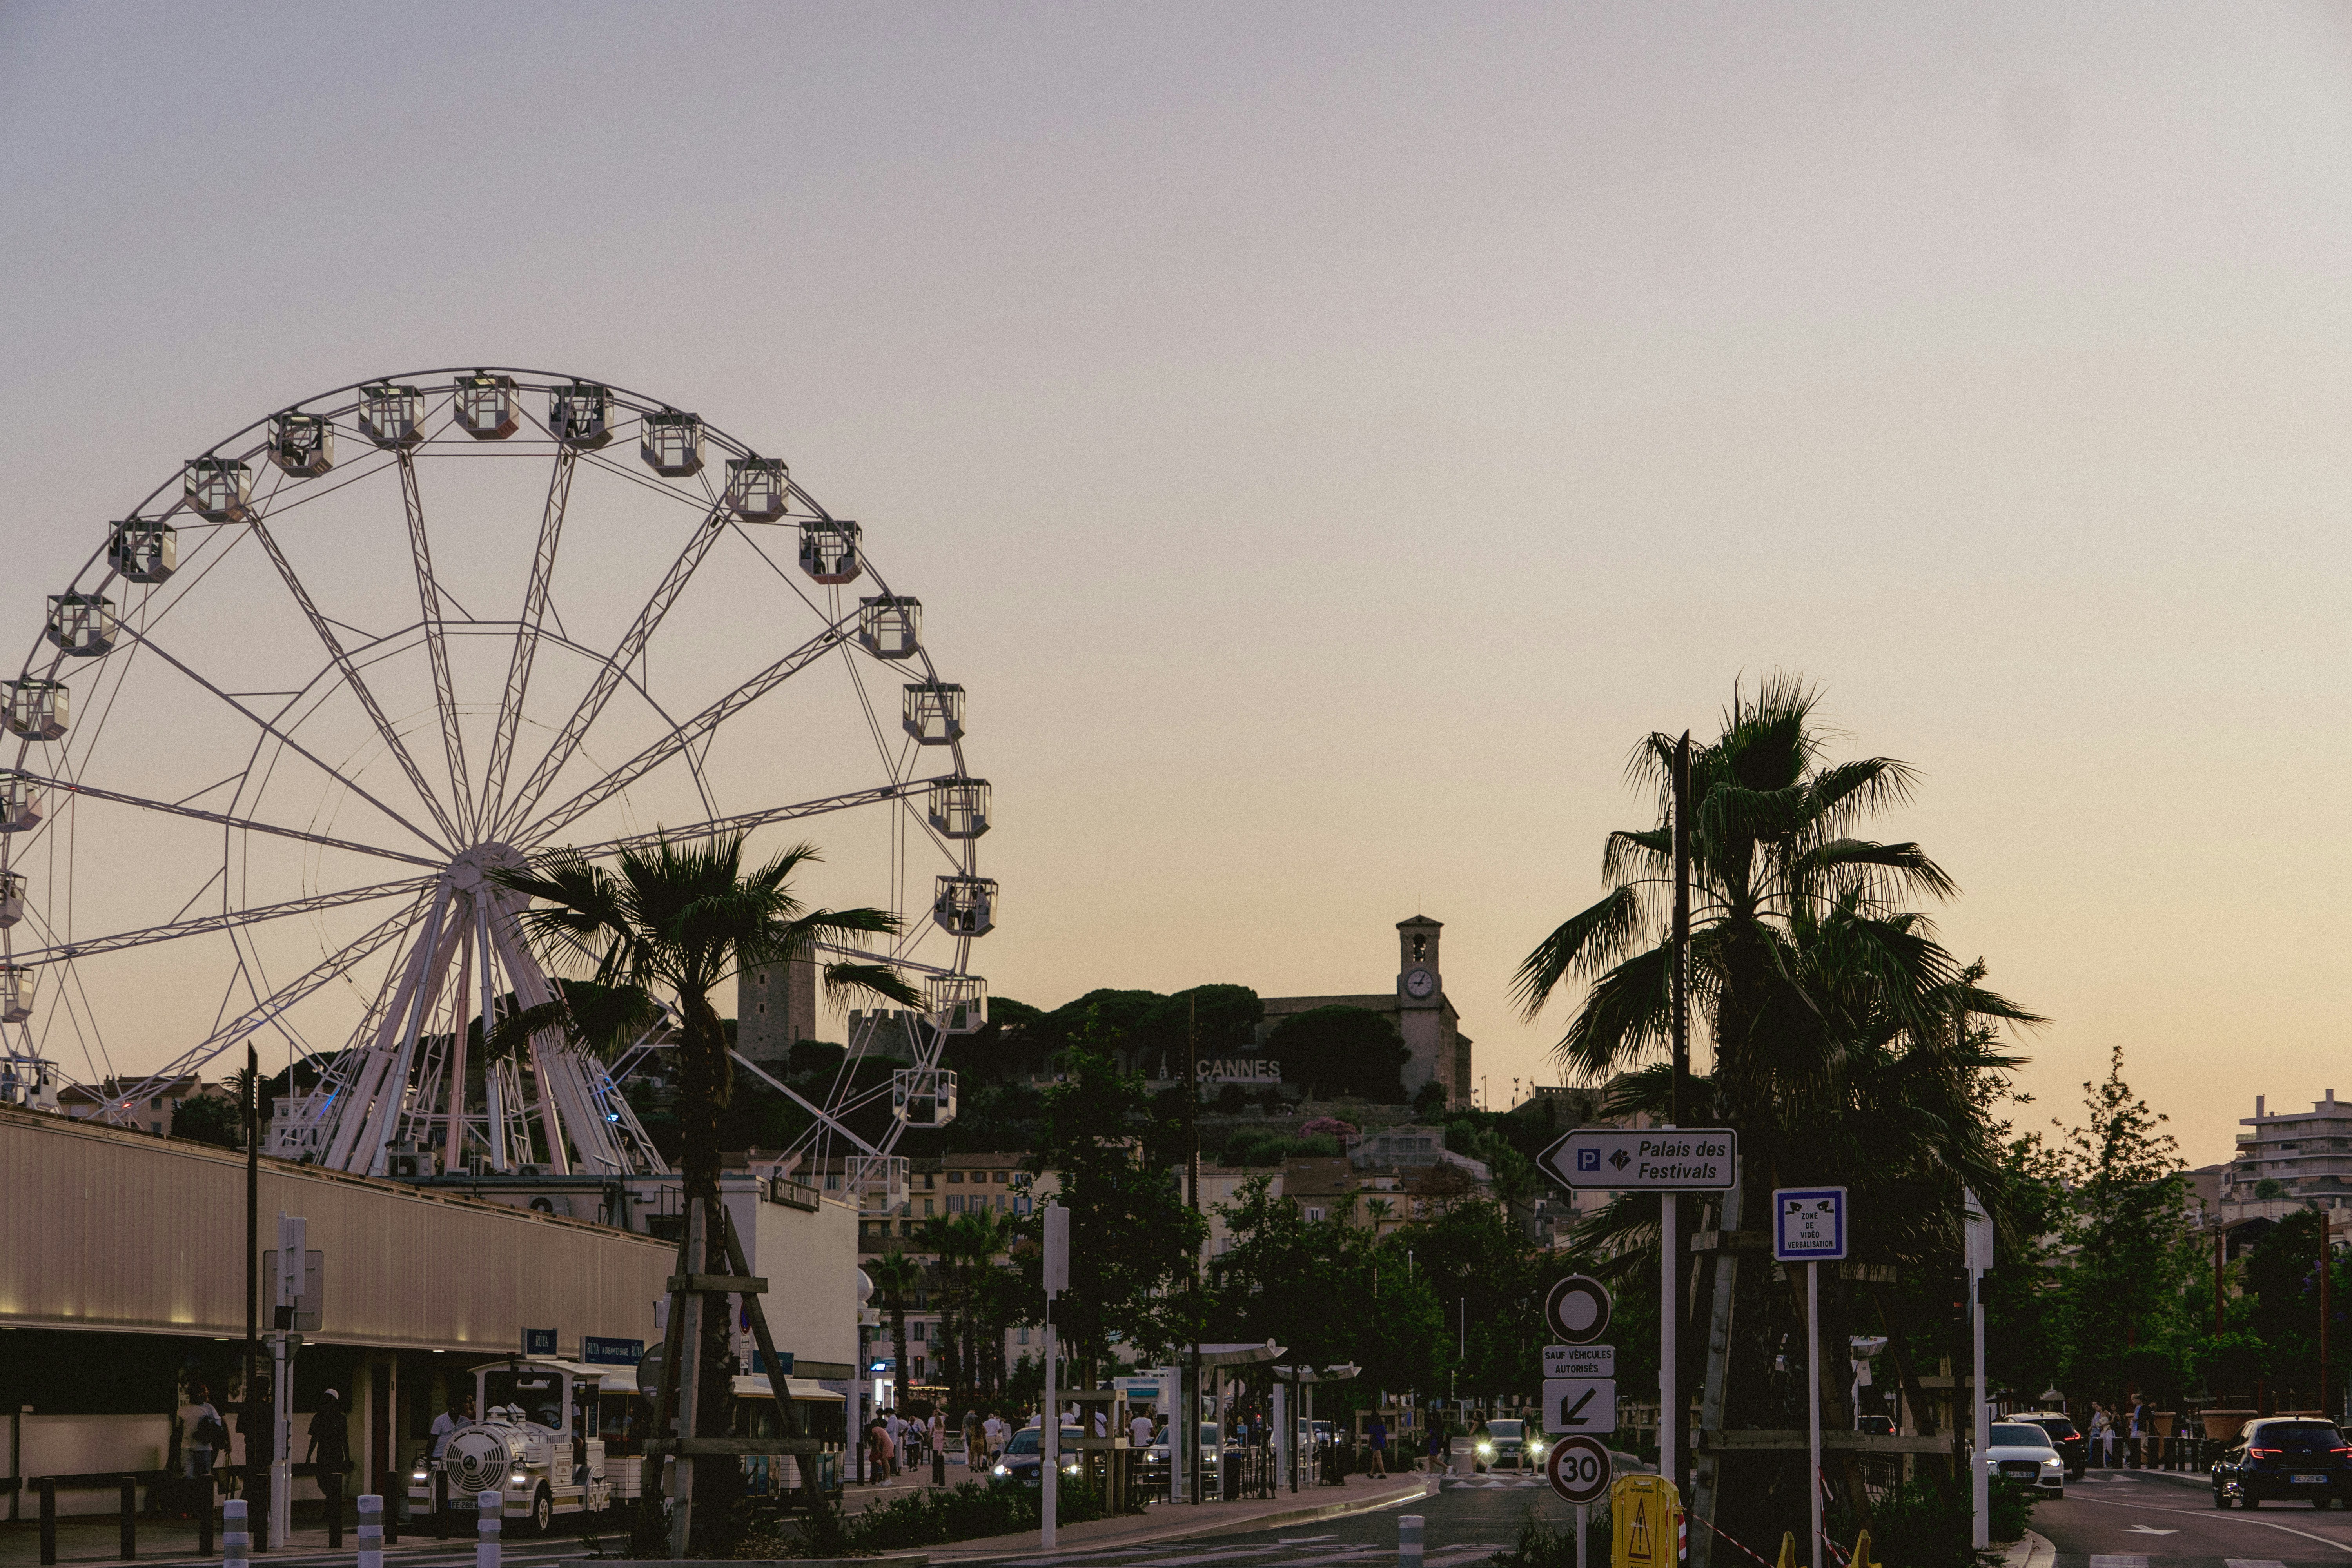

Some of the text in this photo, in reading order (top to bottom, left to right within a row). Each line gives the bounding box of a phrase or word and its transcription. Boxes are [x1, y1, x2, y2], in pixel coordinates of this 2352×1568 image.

[1196, 1059, 1281, 1077] CANNES
[1639, 1141, 1725, 1157] Palais des
[1639, 1162, 1717, 1179] Festivals
[777, 1181, 818, 1207] GARE MARITIME
[1800, 1230, 1820, 1238] VIDÉO
[1788, 1240, 1833, 1249] VERBALISATION
[1545, 1349, 1612, 1360] SAUF VÉHICULES
[1555, 1363, 1599, 1374] AUTORISÉS
[1562, 1456, 1598, 1483] 30
